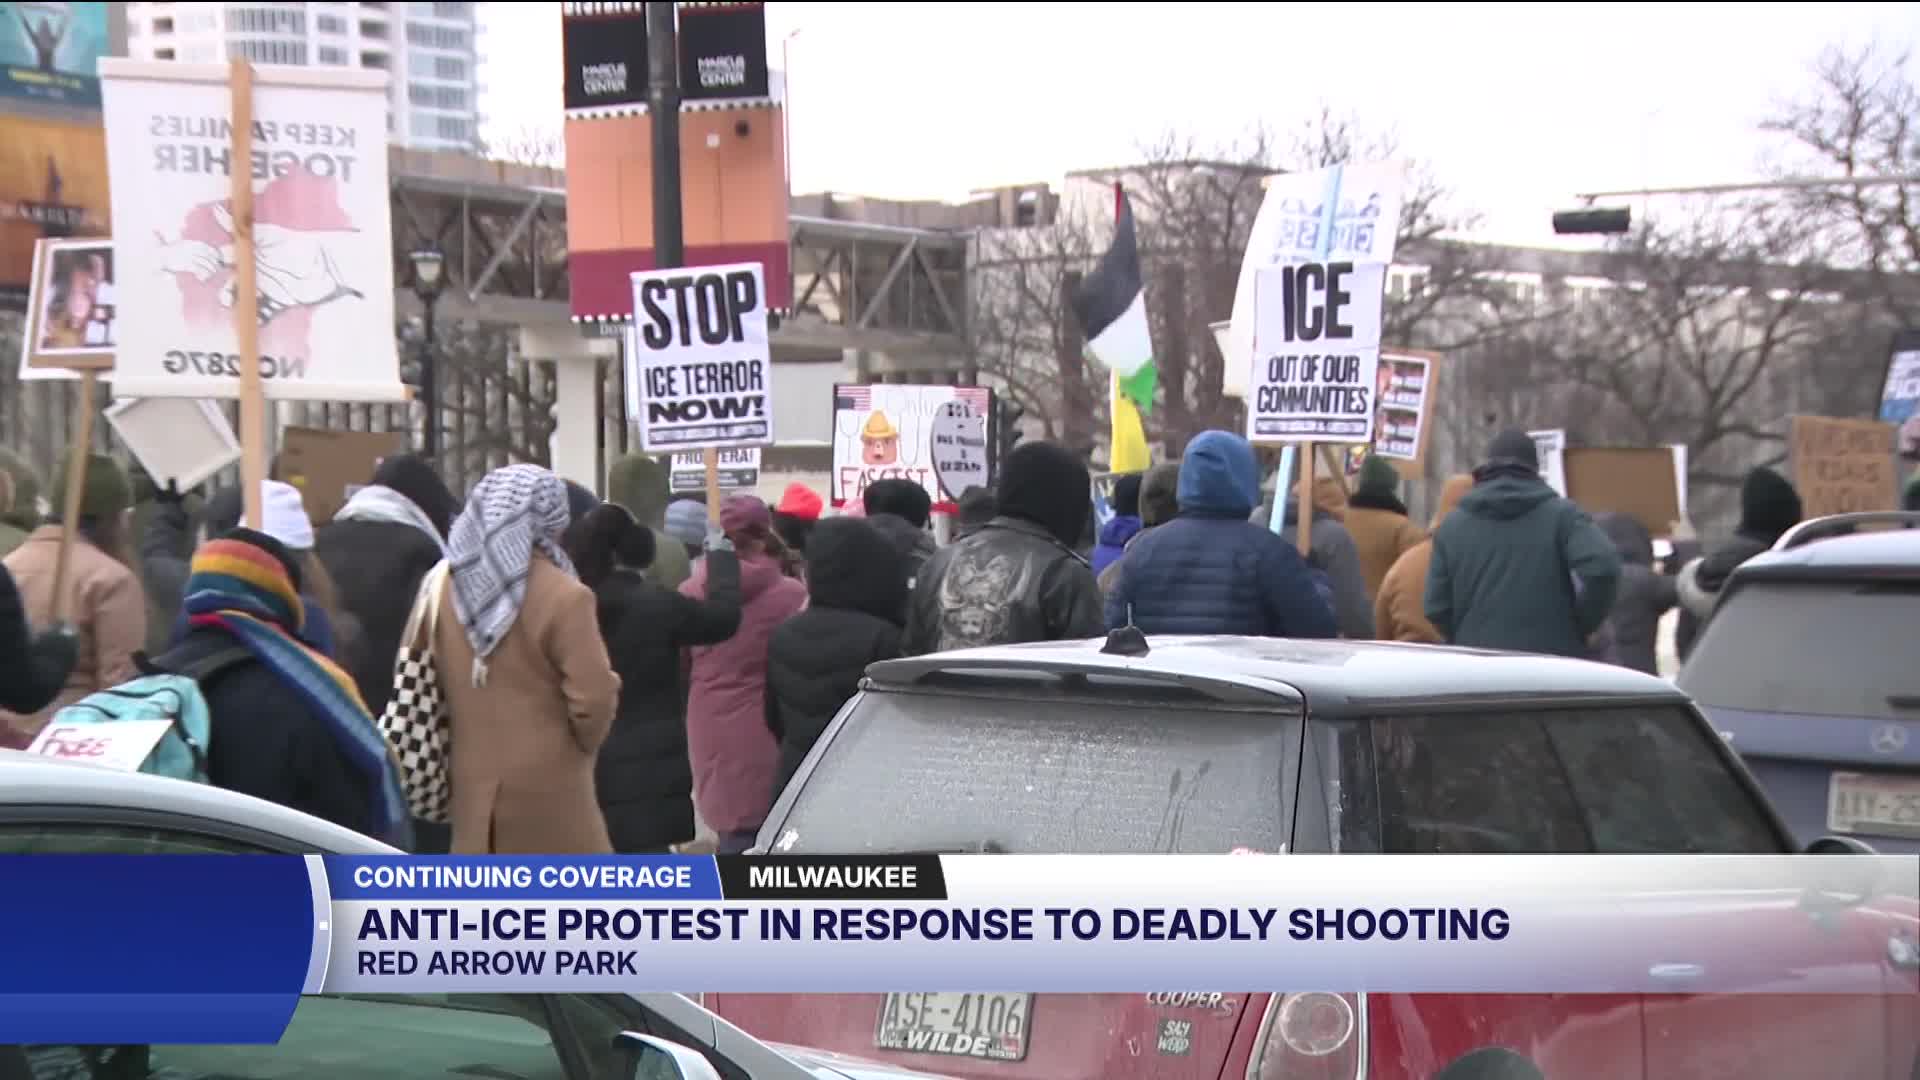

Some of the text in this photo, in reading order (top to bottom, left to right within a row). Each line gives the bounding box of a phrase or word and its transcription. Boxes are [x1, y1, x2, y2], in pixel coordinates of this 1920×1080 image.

[584, 80, 627, 96] CENTER
[700, 74, 745, 88] CENTER
[641, 271, 757, 350] STOP
[1282, 262, 1353, 342] ICE
[646, 359, 763, 398] ICE TERROR
[1268, 354, 1361, 383] OUT OF OUR
[648, 395, 765, 424] NOW!
[1257, 385, 1369, 414] COMMUNITIES
[884, 992, 1021, 1036] ASE-4106
[1146, 992, 1222, 1009] COOPER
[906, 1030, 991, 1056] WILDE
